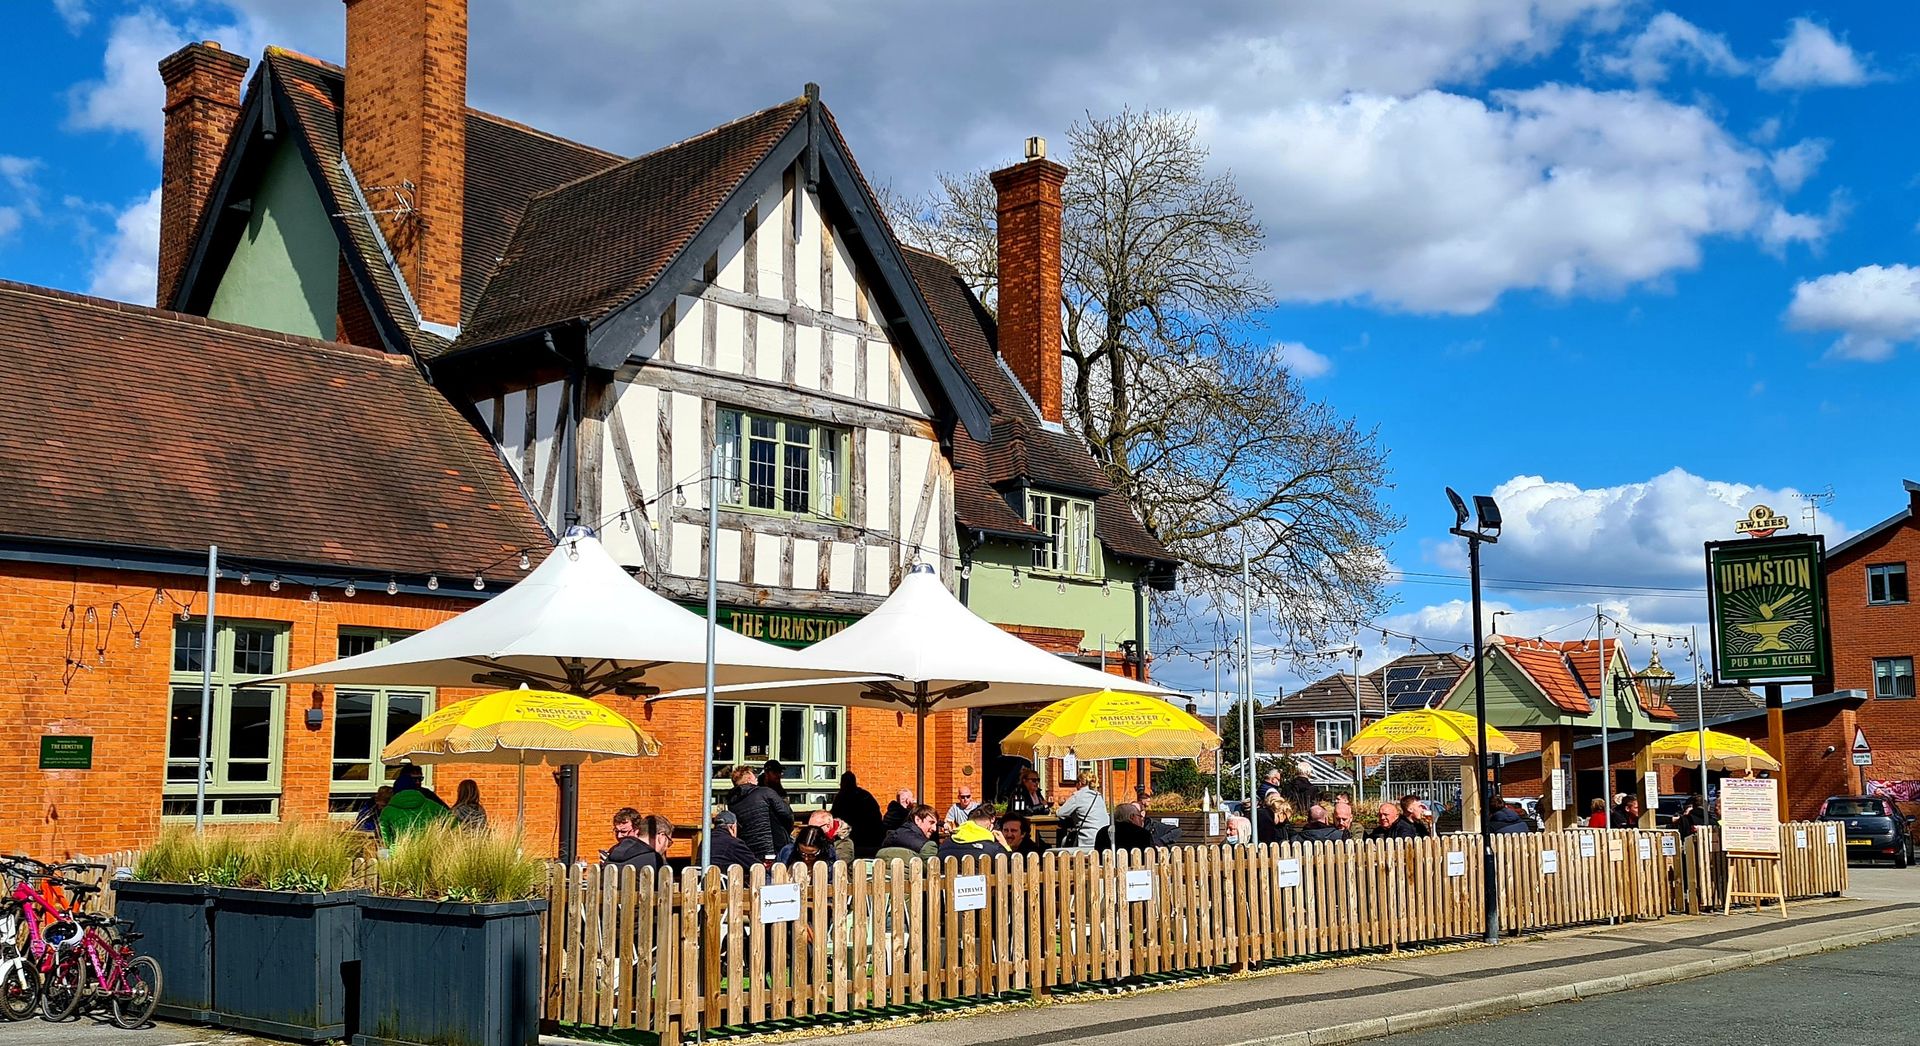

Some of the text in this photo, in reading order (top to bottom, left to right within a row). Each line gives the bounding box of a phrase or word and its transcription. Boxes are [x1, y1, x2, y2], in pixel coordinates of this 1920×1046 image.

[1721, 557, 1811, 595] URMSTON
[730, 612, 764, 638] THE
[1731, 654, 1812, 668] PUB AND KITCHEN
[526, 707, 592, 716] MANCHESTER
